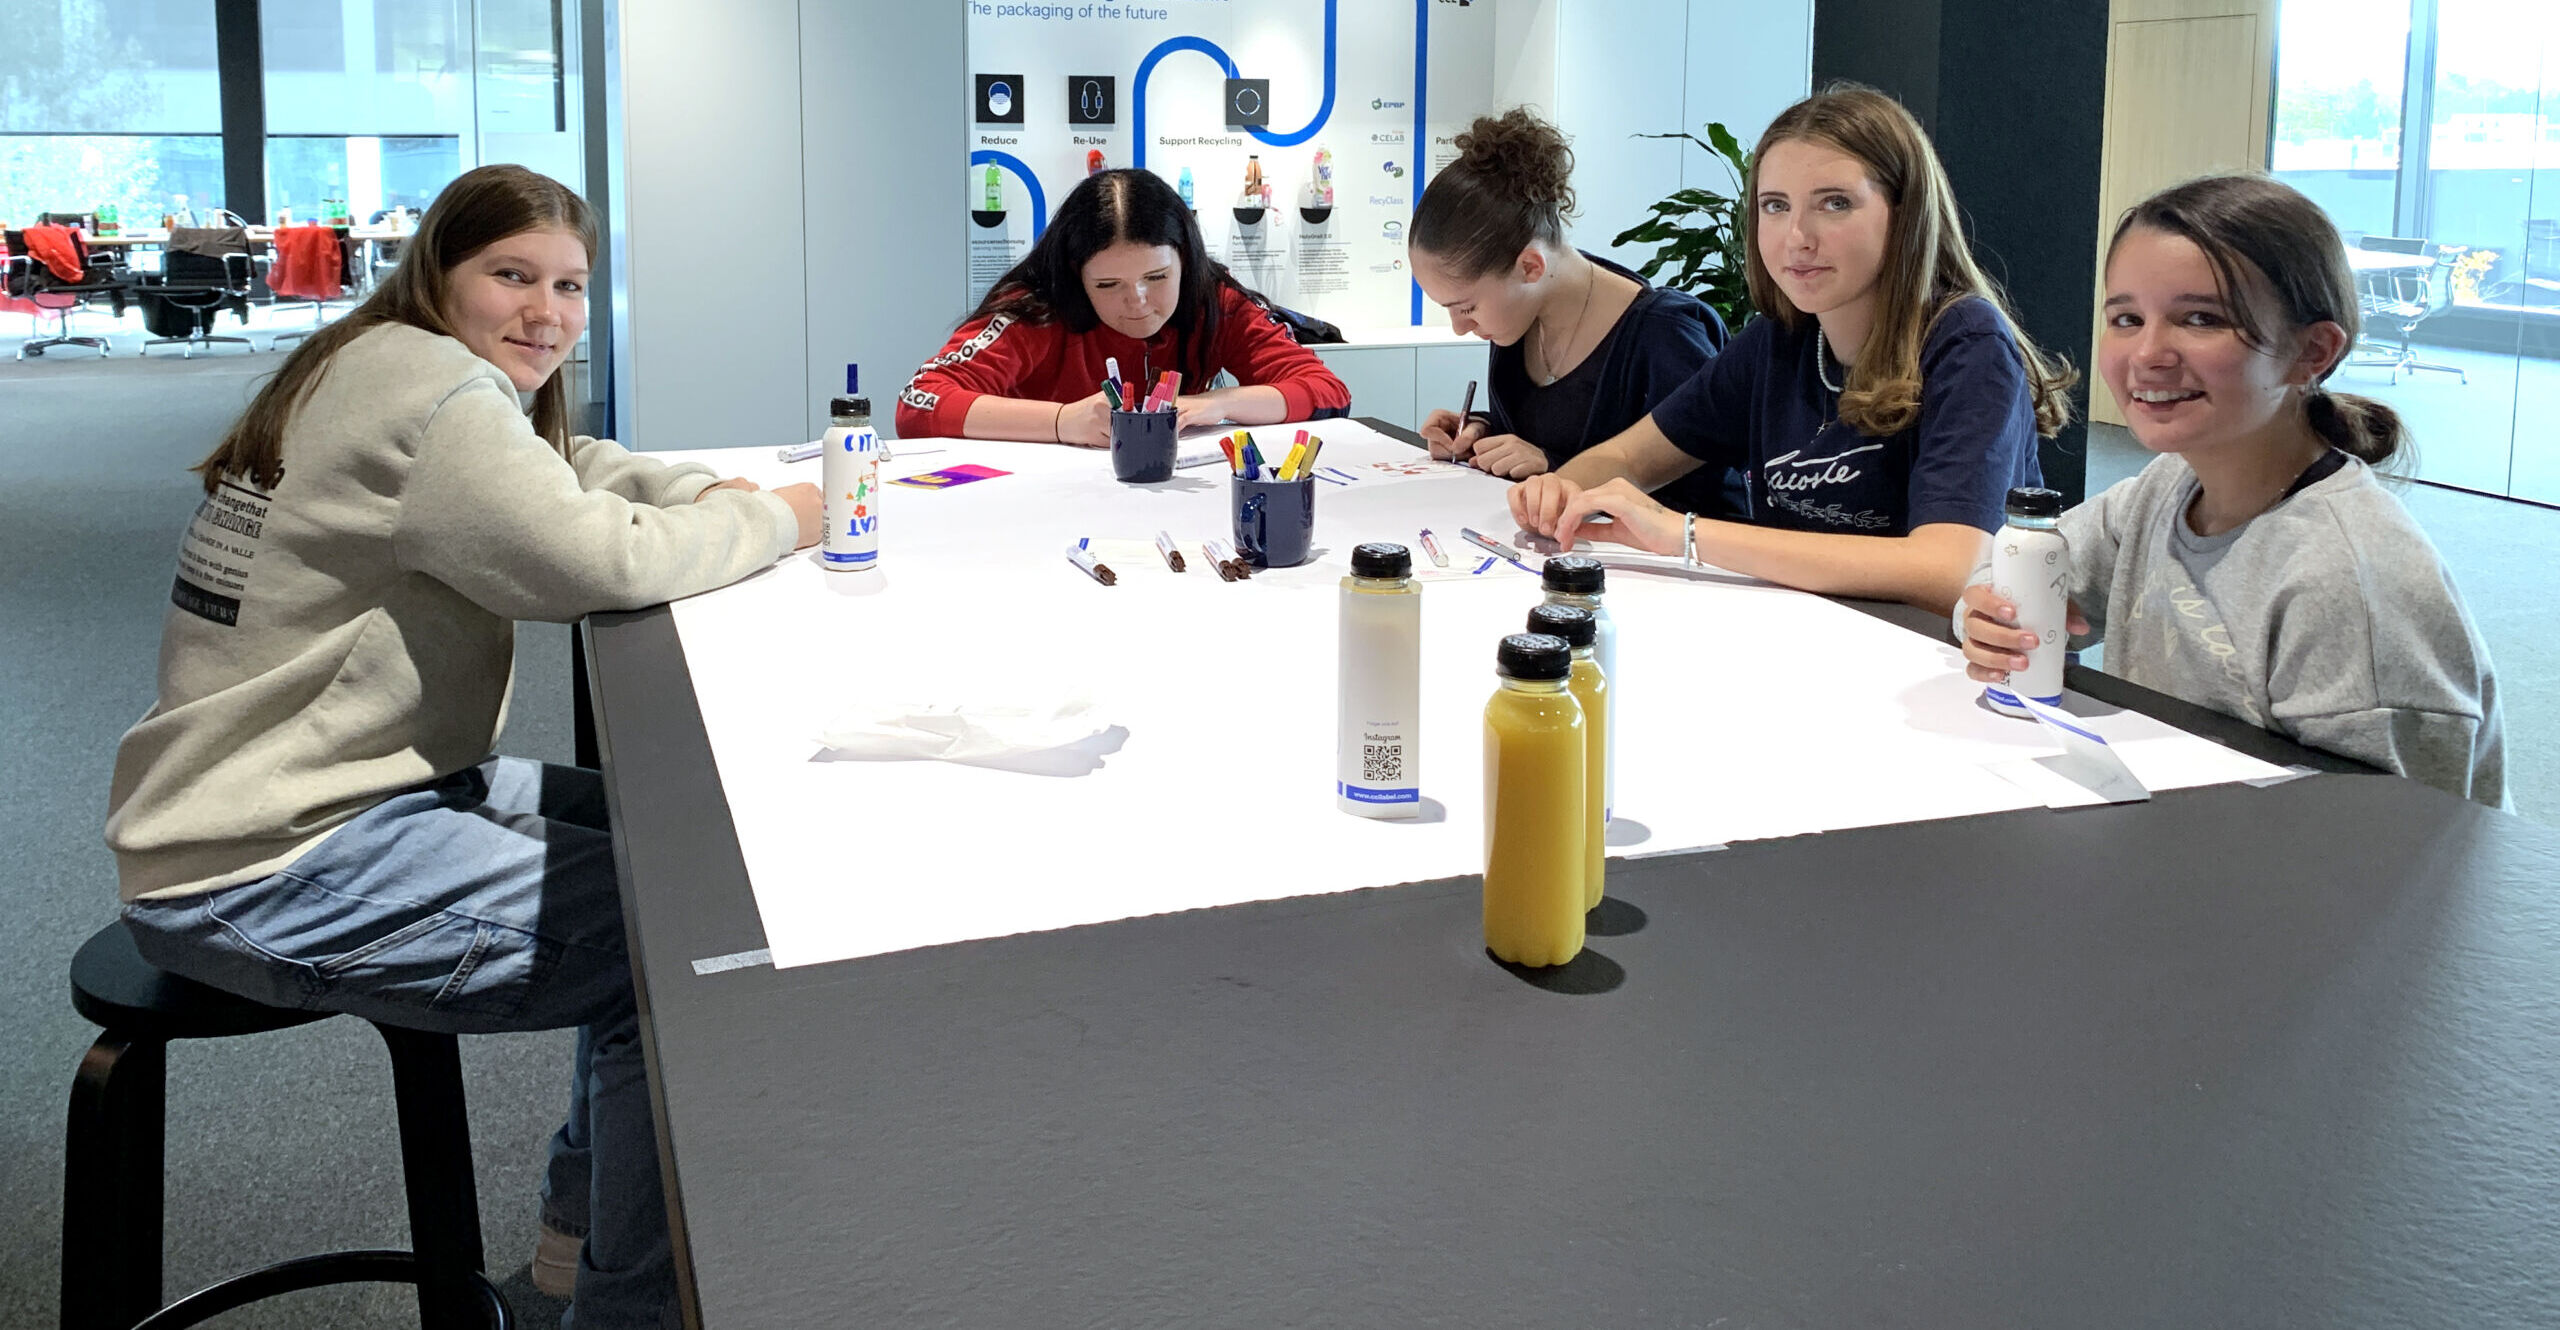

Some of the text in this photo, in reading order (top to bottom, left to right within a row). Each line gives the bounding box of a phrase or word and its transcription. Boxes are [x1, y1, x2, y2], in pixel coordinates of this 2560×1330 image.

[968, 0, 1168, 20] he packaging of the future
[981, 136, 1018, 145] Reduce
[1073, 136, 1107, 146] Re-Use
[1159, 137, 1242, 147] Support Recycling
[1435, 137, 1453, 145] Part
[212, 507, 263, 540] CHANGE
[1364, 732, 1401, 743] Instagram
